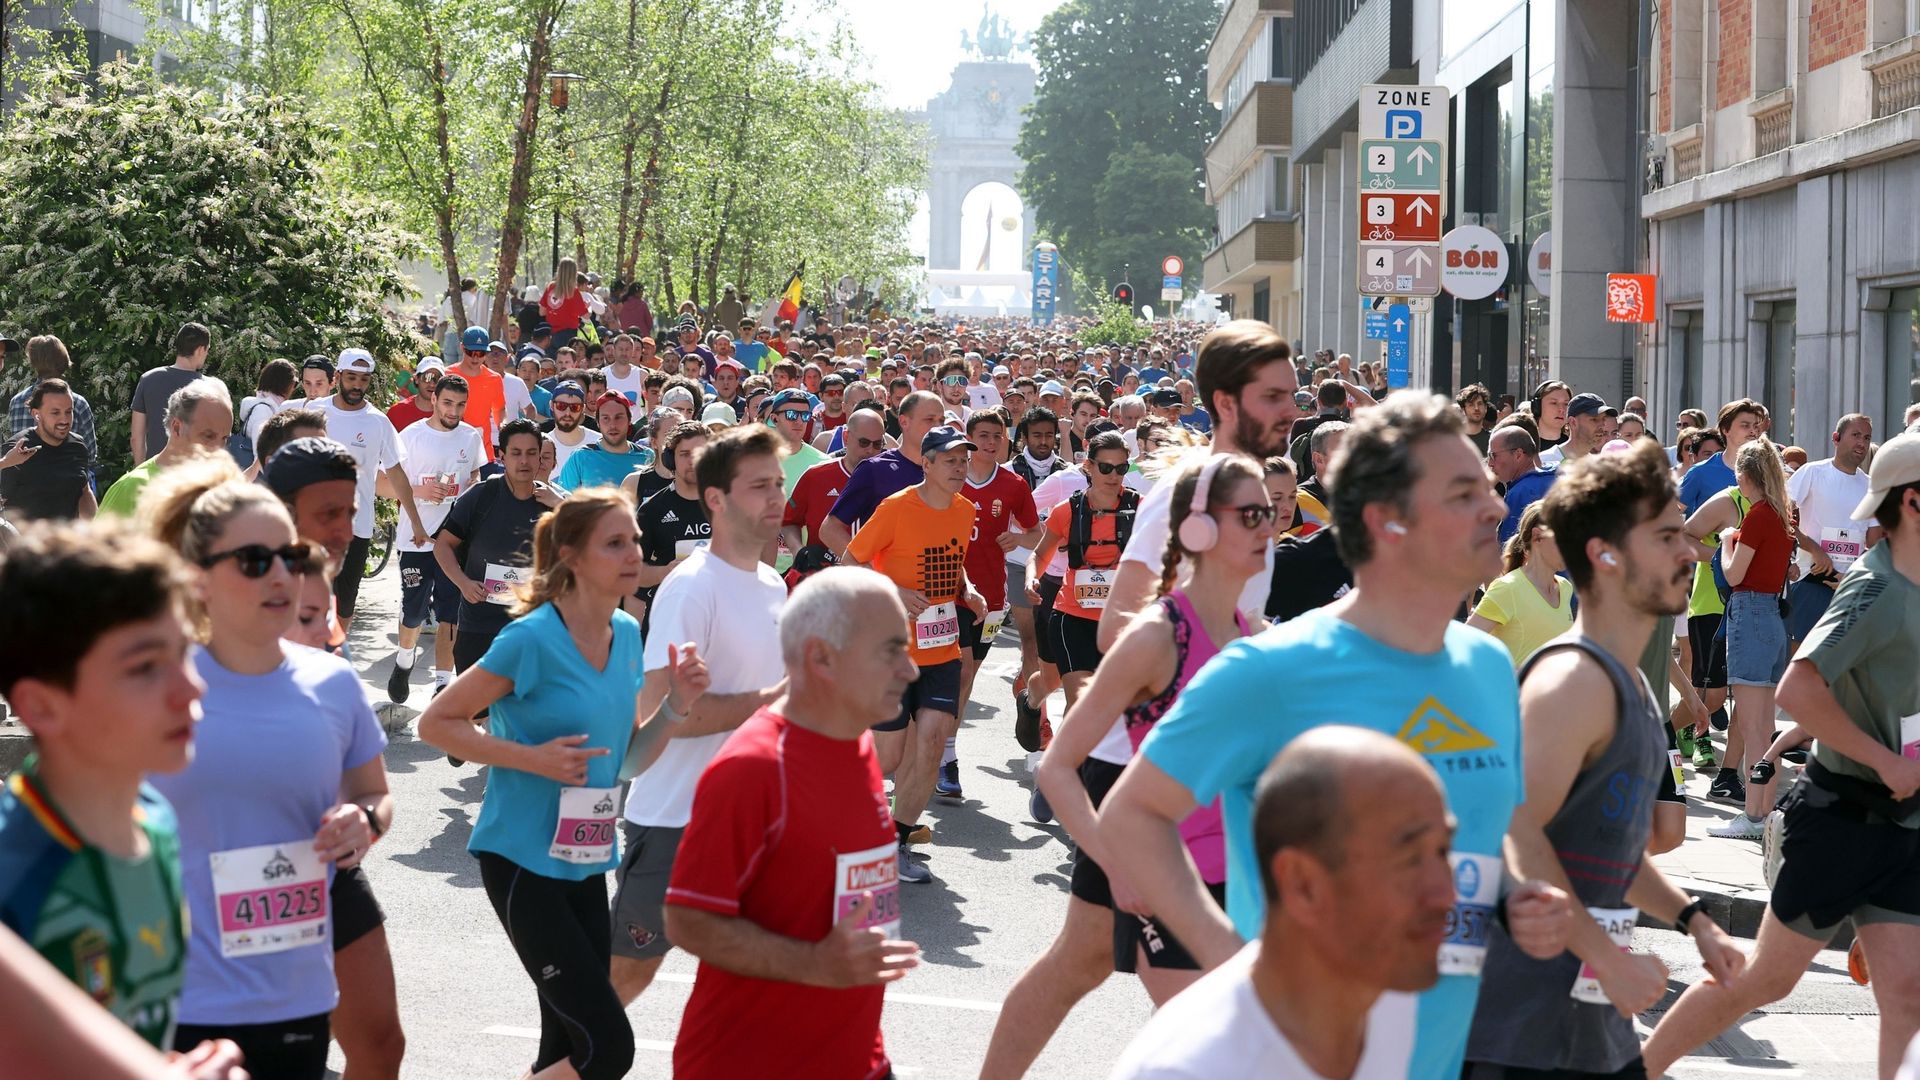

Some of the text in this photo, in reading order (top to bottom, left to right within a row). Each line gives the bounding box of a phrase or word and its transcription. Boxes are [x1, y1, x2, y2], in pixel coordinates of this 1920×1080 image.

[1377, 91, 1431, 106] ZONE
[1392, 115, 1415, 139] P
[1377, 154, 1386, 165] 2
[1376, 205, 1385, 217] 3
[1375, 257, 1384, 268] 4
[1036, 253, 1052, 309] START
[1395, 349, 1401, 357] 5
[684, 522, 712, 536] AIG
[1828, 543, 1854, 553] 9679
[503, 573, 519, 581] SPA
[924, 620, 956, 637] 10220
[1444, 754, 1506, 771] TRAIL
[593, 803, 614, 814] SPA
[574, 823, 611, 843] 670
[263, 864, 297, 881] SPA
[235, 888, 321, 923] 41225
[1137, 914, 1165, 954] IKE
